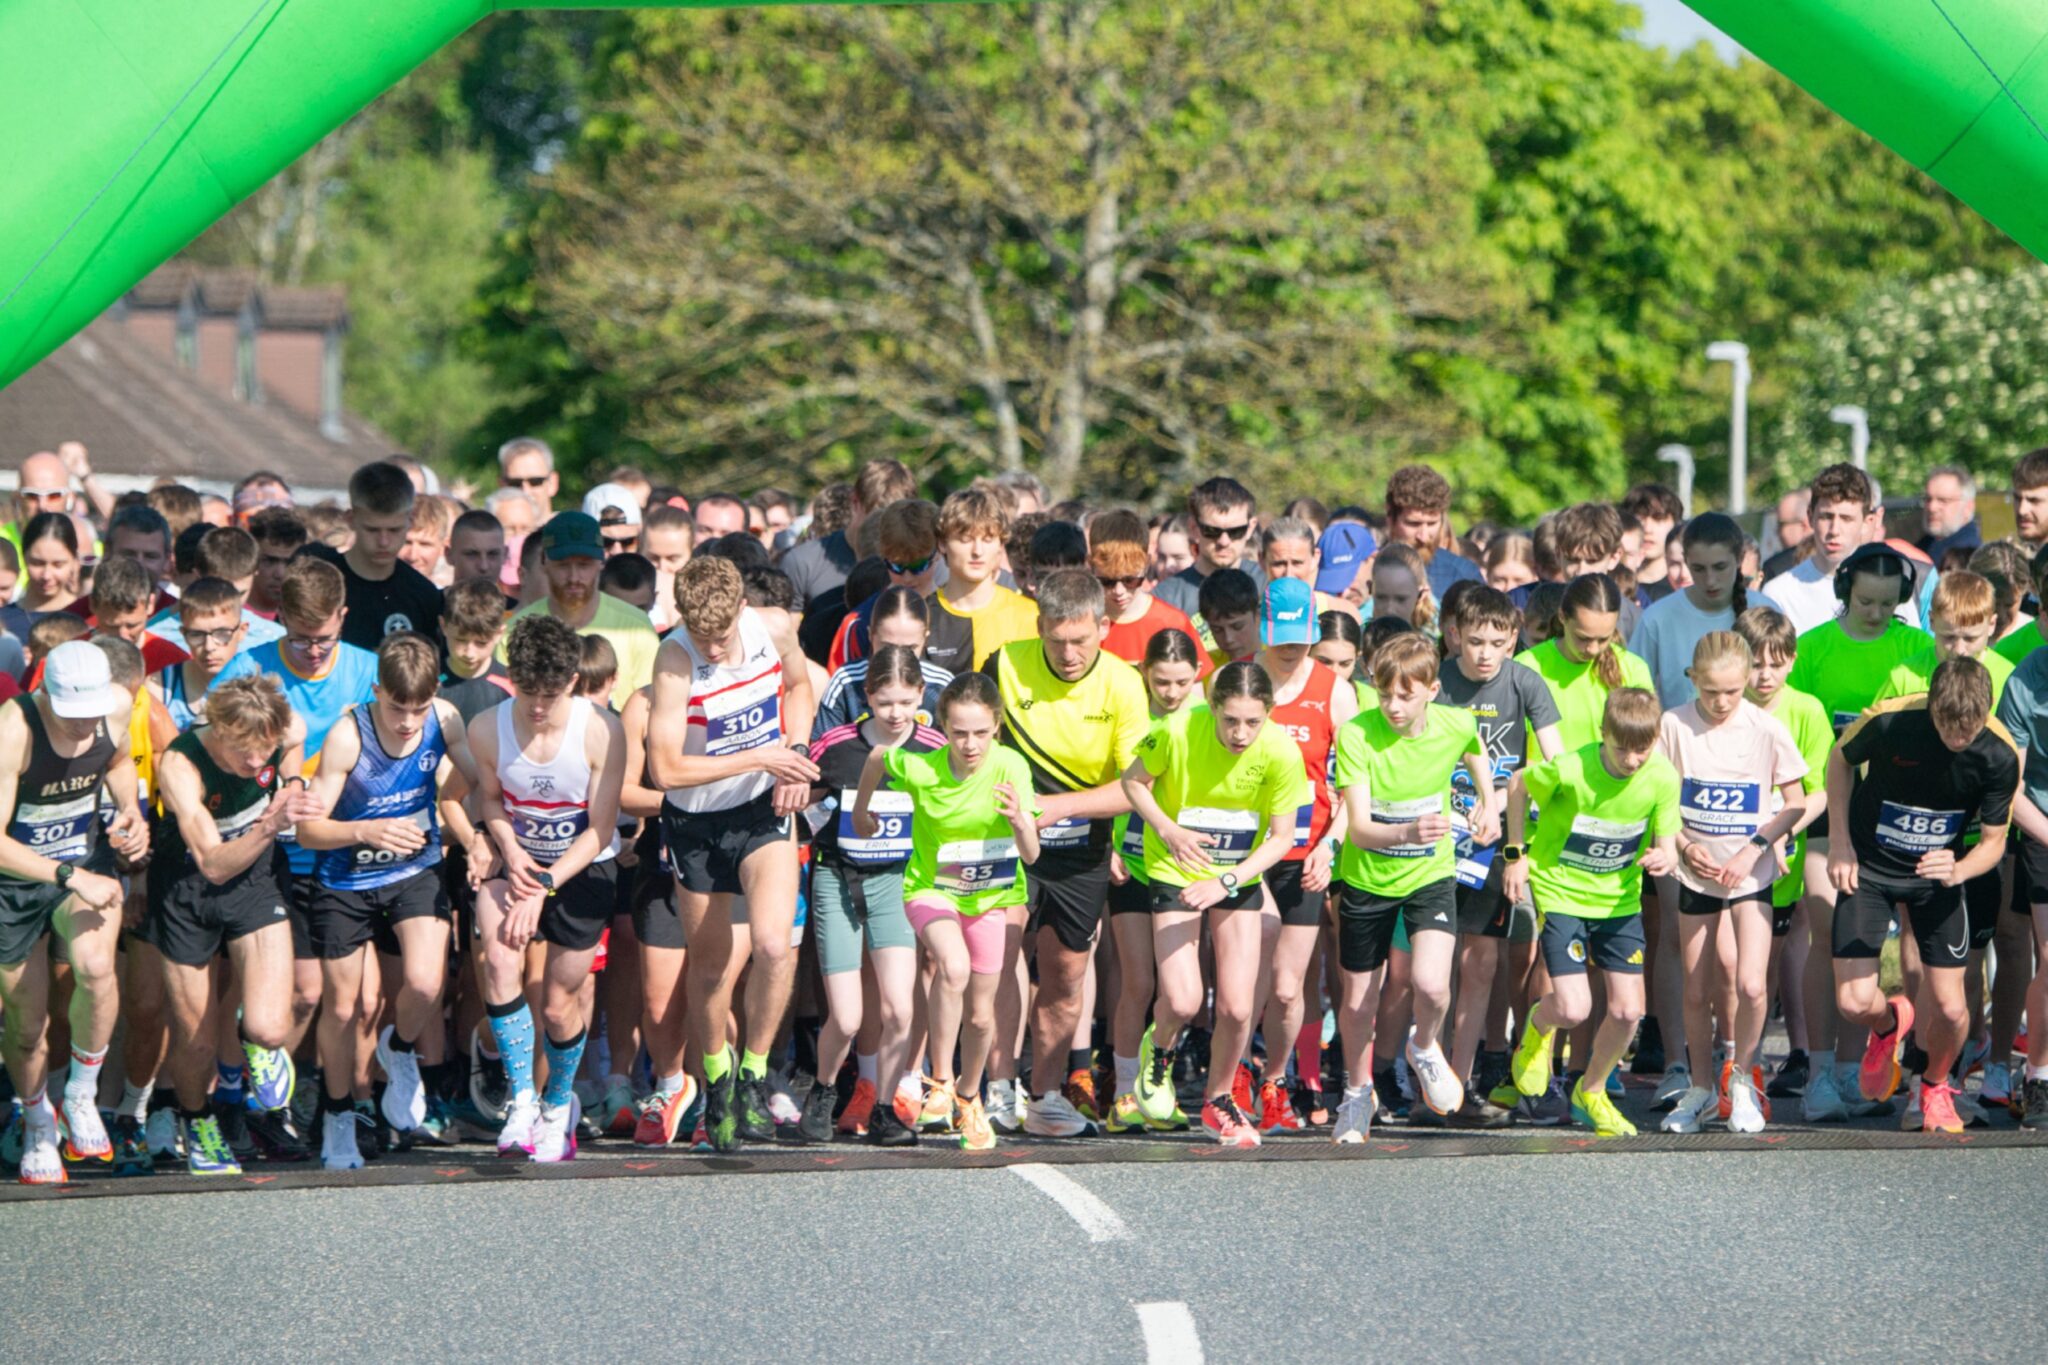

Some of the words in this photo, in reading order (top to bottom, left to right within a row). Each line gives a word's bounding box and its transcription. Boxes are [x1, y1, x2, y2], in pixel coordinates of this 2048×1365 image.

[1481, 703, 1497, 711] run
[722, 706, 764, 736] 310
[1694, 788, 1744, 811] 422
[1699, 812, 1737, 823] GRACE
[1893, 814, 1948, 834] 486
[30, 821, 74, 844] 301
[525, 820, 576, 840] 240
[1588, 842, 1623, 858] 68
[961, 864, 993, 881] 83
